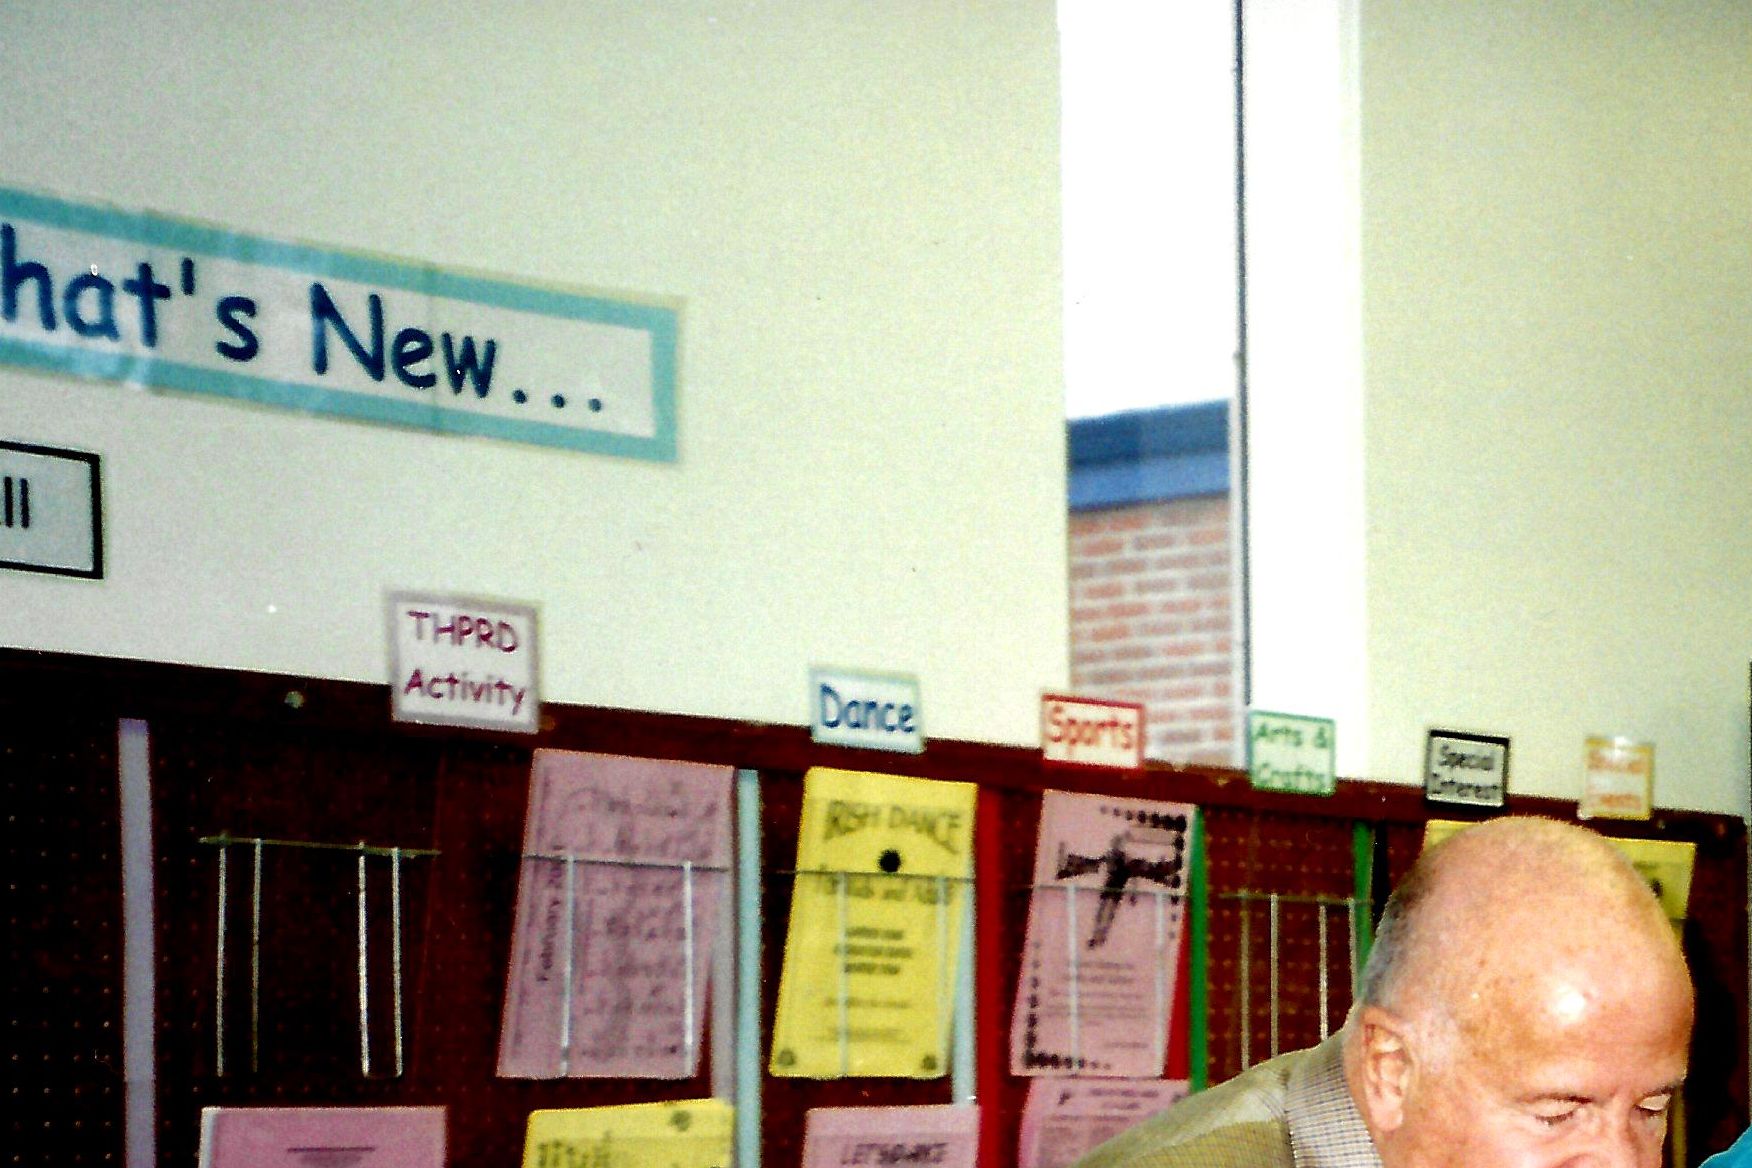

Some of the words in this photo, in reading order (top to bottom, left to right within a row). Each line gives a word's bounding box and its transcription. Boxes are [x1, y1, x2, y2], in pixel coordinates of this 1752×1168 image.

[0, 222, 259, 362] hat's
[406, 608, 521, 654] THPRD
[404, 667, 529, 716] Activity
[819, 683, 915, 734] Dance
[1046, 704, 1134, 754] Sports
[1438, 744, 1495, 771] Special
